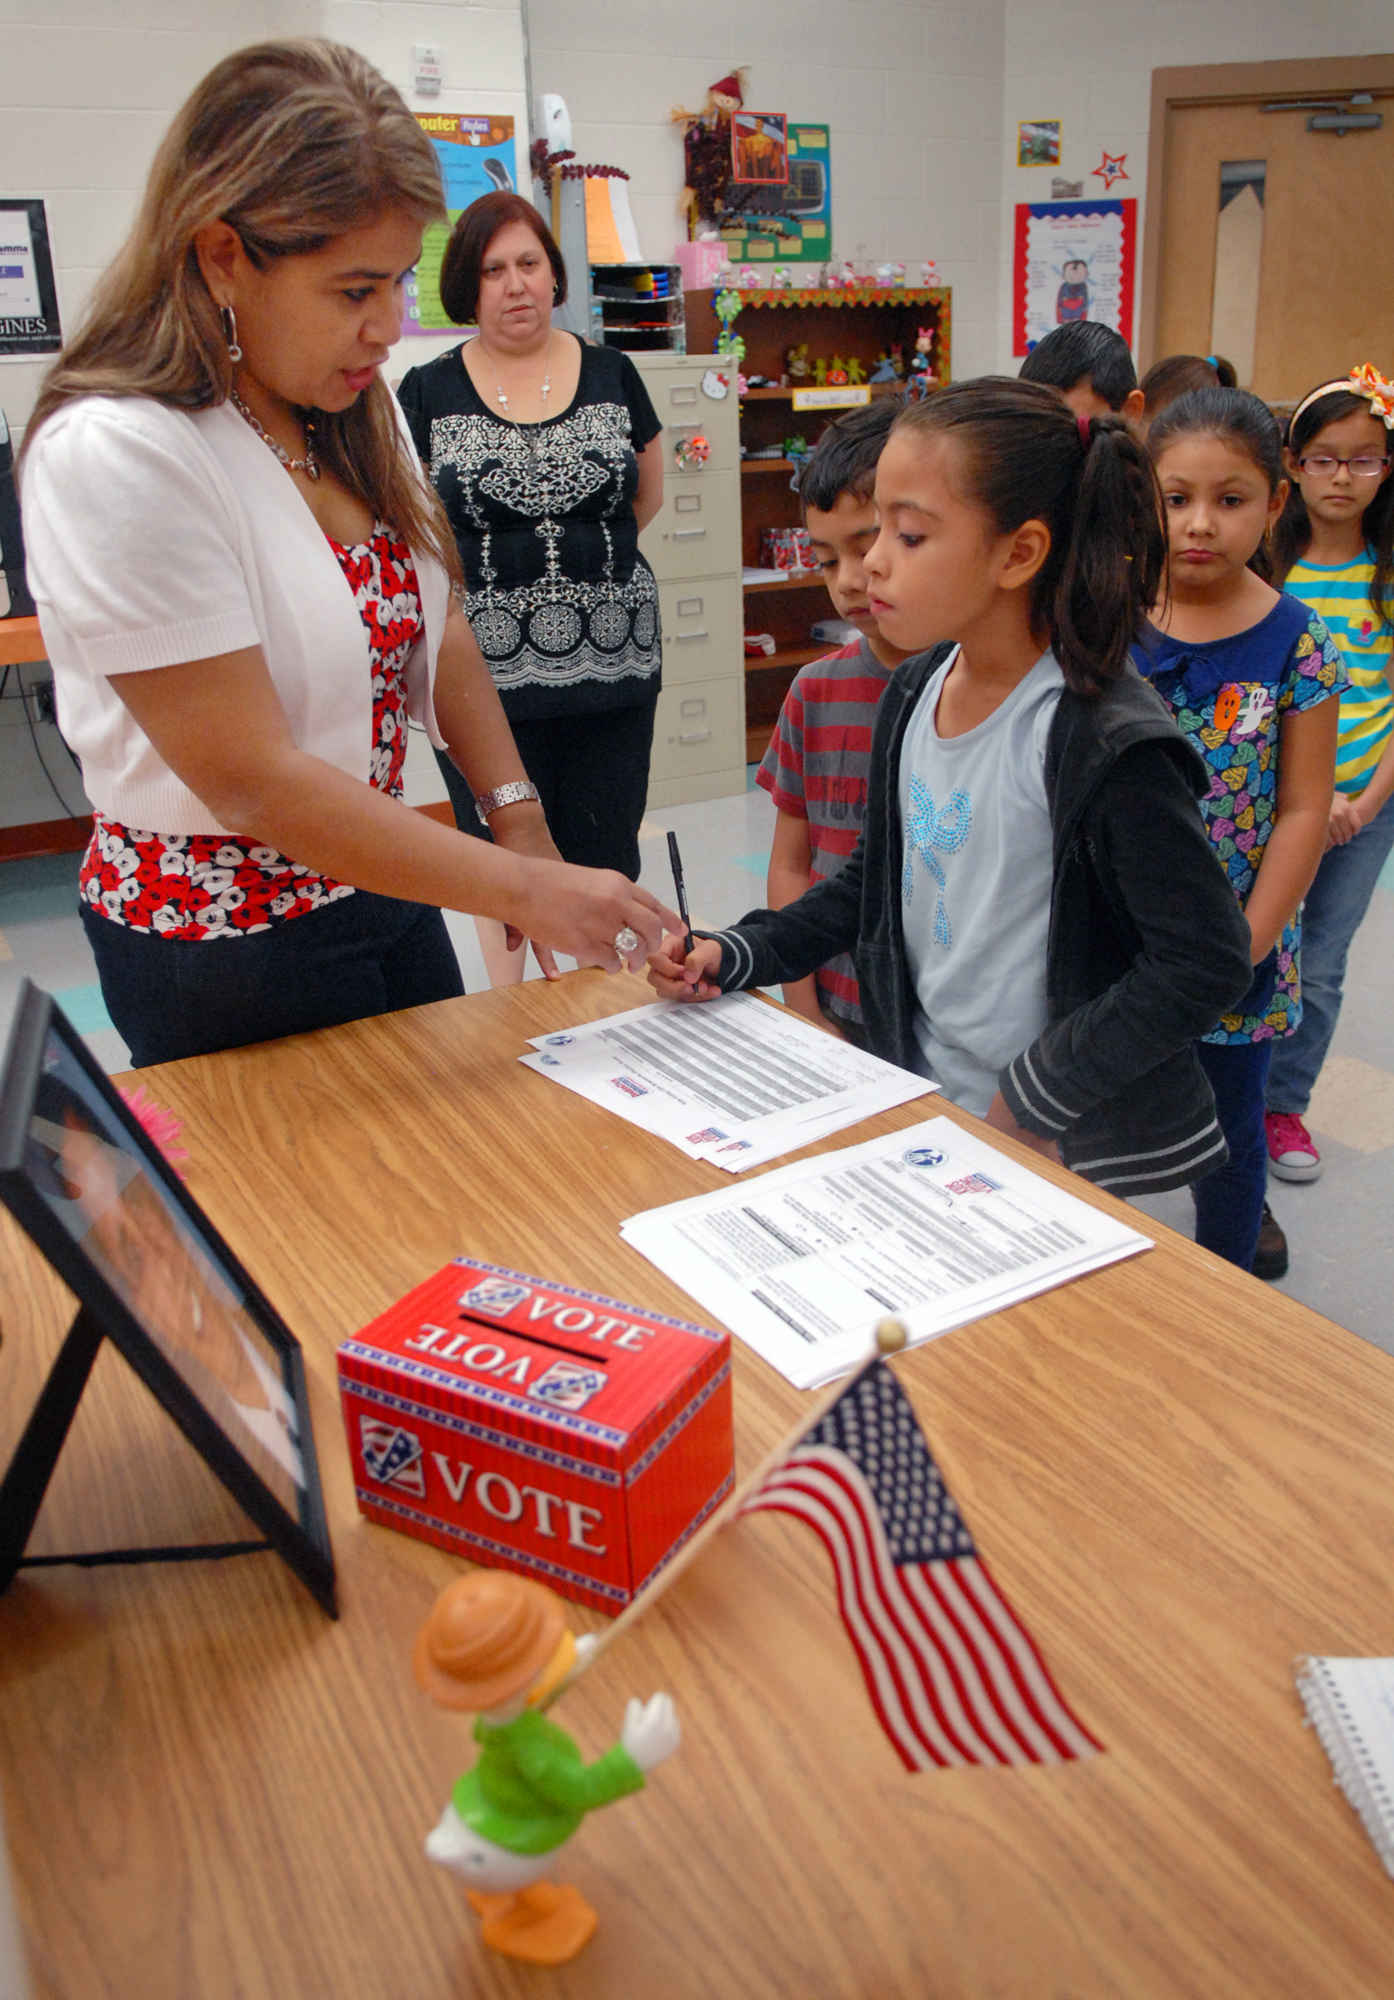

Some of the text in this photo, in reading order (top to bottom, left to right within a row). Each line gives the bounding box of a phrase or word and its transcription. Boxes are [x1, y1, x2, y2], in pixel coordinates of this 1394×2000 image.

[419, 66, 440, 76] FIRE
[462, 120, 488, 131] Rules
[944, 1179, 969, 1196] KIDS
[527, 1295, 656, 1352] VOTE
[404, 1323, 532, 1384] VOTE
[431, 1450, 607, 1555] VOTE
